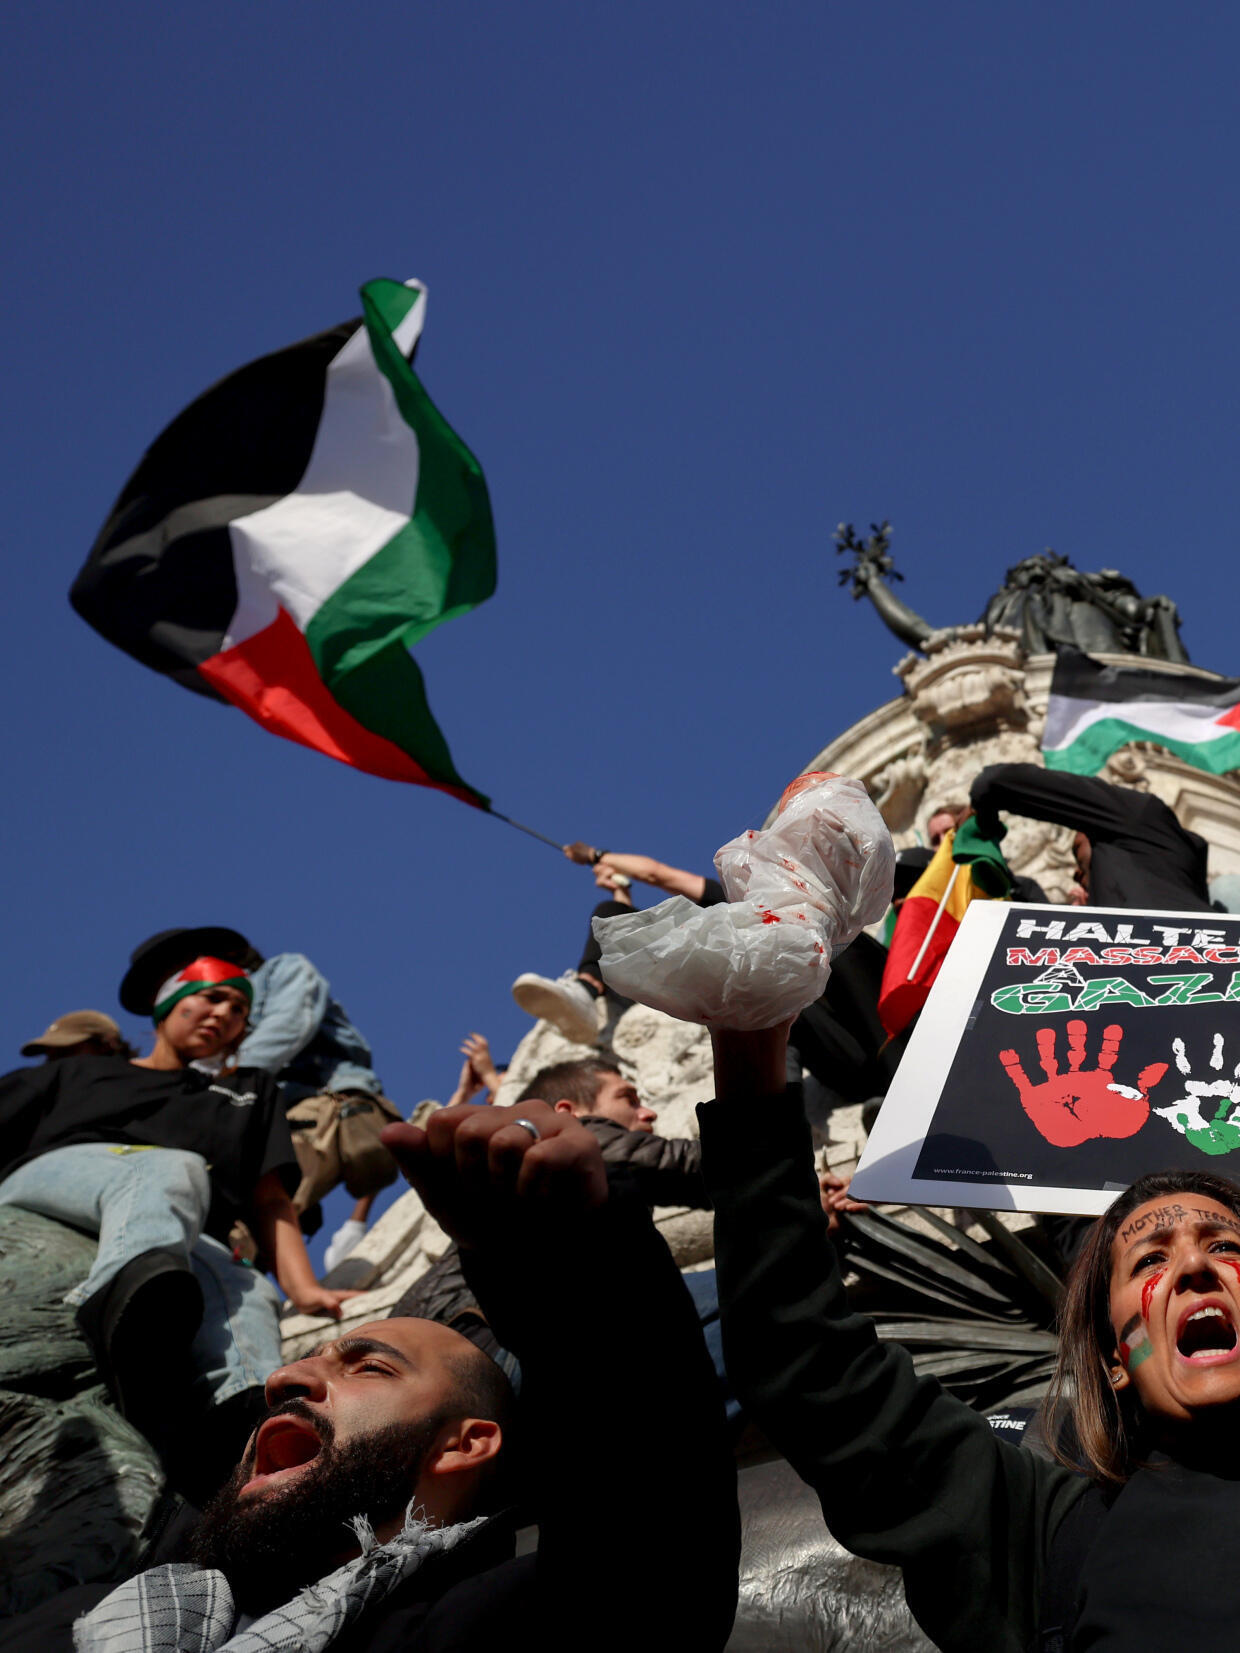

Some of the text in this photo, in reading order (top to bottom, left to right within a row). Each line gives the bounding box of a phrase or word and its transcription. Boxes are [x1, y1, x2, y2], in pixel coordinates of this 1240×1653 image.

[1016, 919, 1226, 948] HALTE
[933, 1168, 1033, 1179] www.france-palestine.org
[1121, 1204, 1188, 1243] MOTHER
